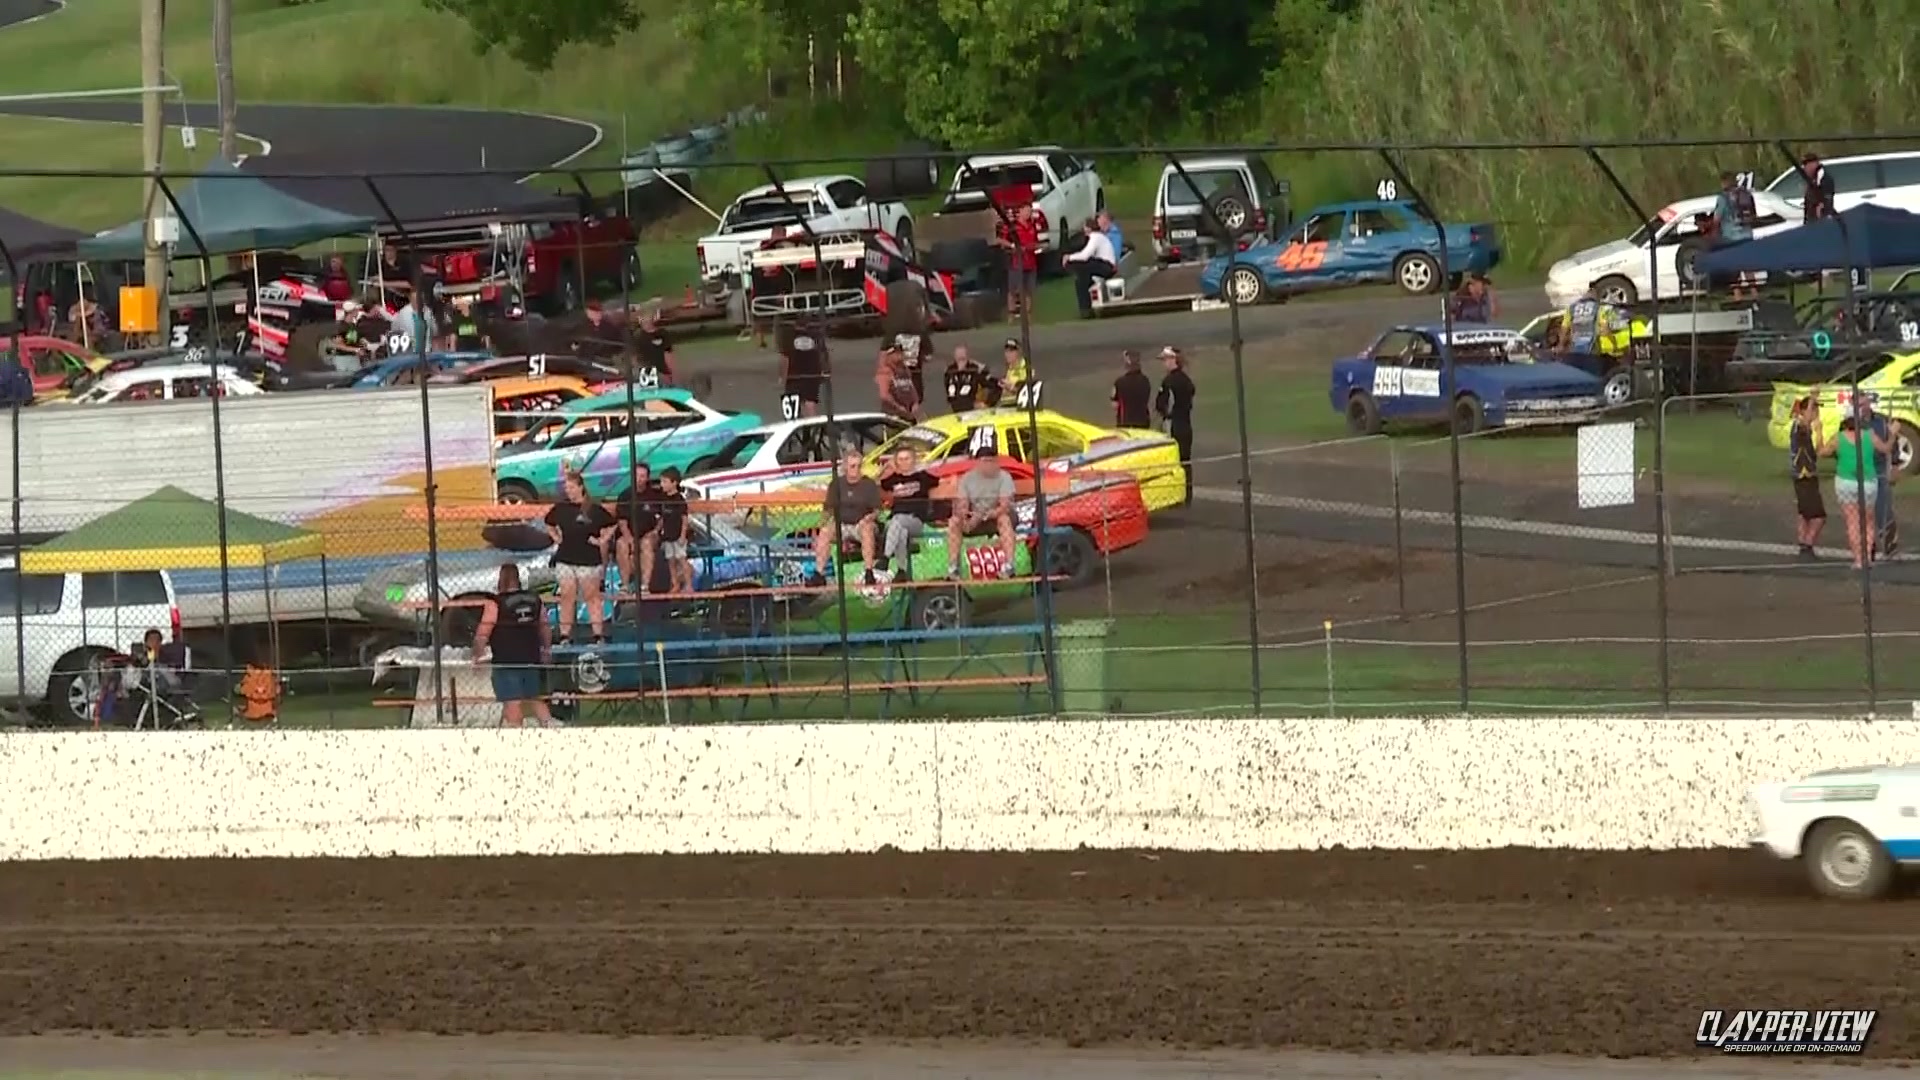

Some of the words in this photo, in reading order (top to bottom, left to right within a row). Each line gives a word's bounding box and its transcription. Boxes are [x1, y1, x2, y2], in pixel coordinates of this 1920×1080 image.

[1377, 179, 1397, 200] 46
[390, 333, 410, 354] 99
[1813, 331, 1831, 359] 9
[528, 353, 546, 375] 51
[640, 367, 658, 387] 64
[1373, 366, 1402, 396] 999
[782, 394, 800, 420] 67
